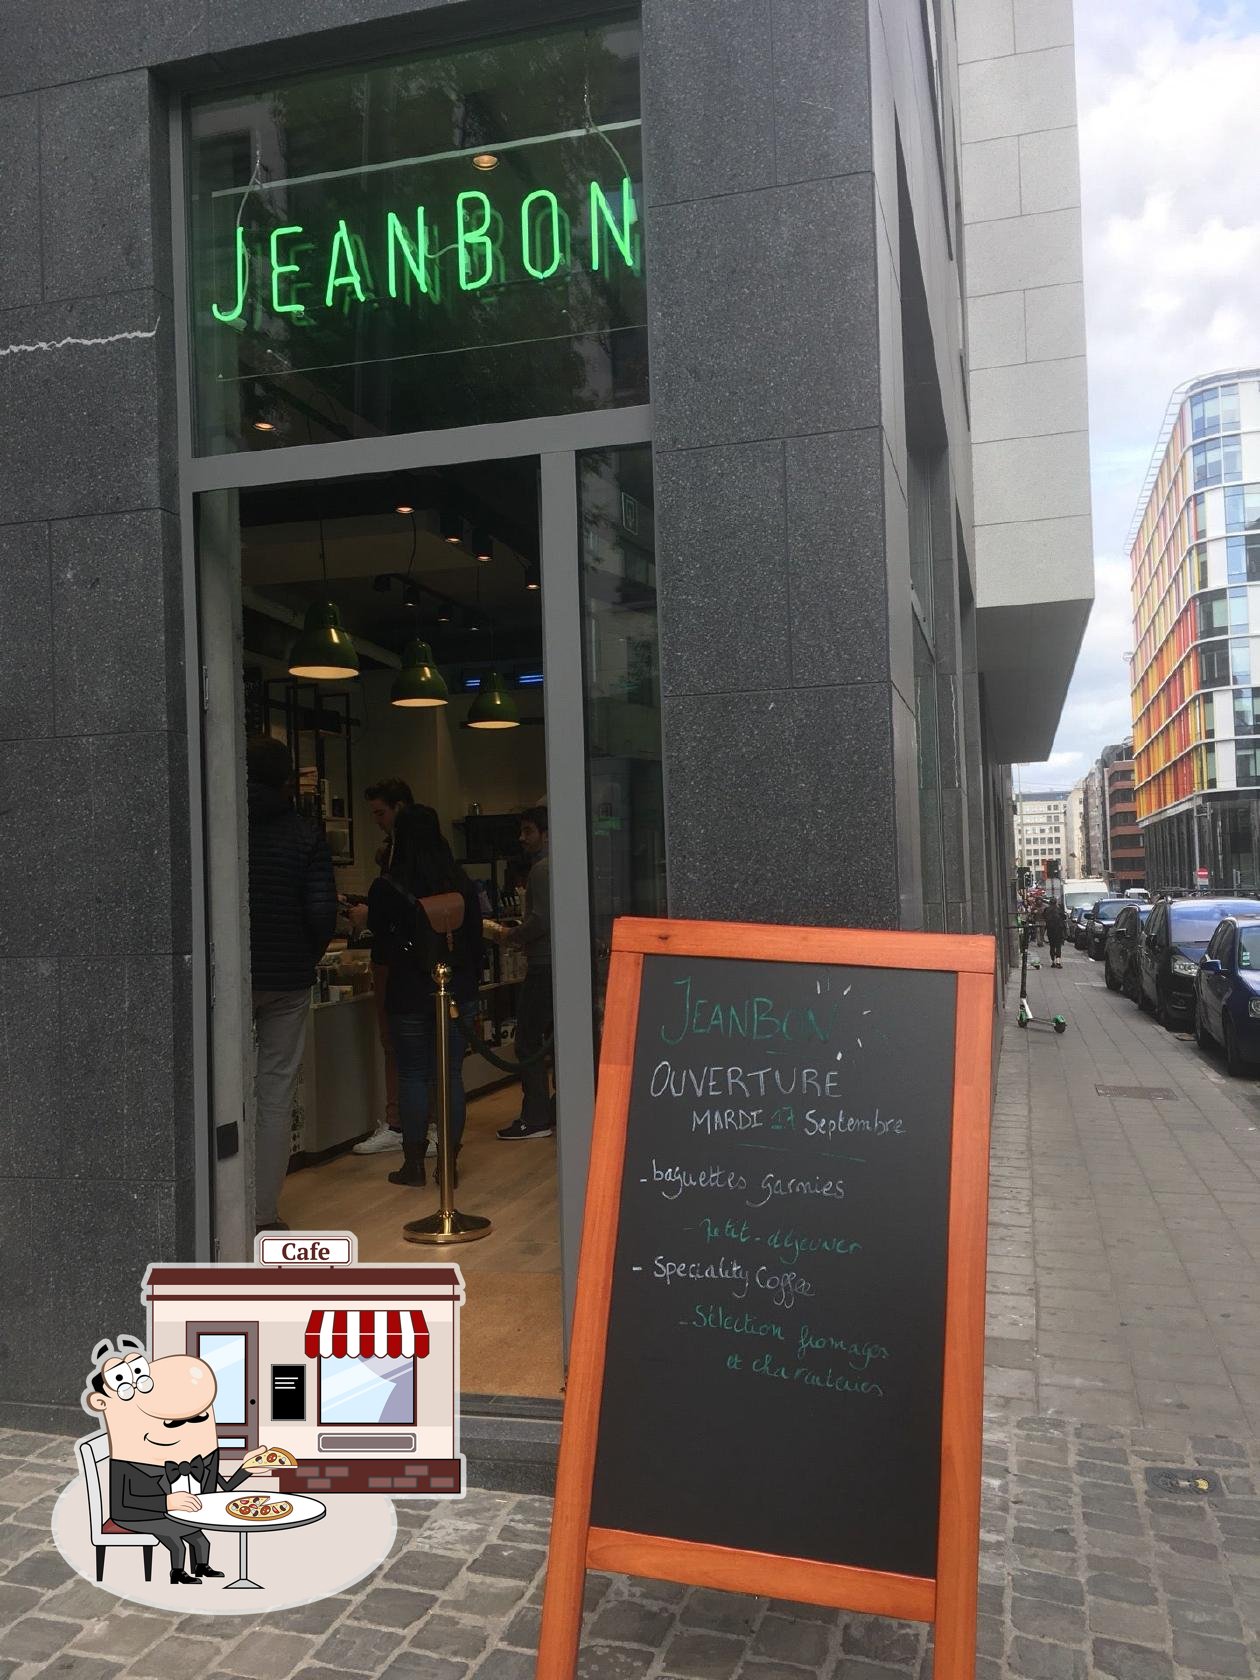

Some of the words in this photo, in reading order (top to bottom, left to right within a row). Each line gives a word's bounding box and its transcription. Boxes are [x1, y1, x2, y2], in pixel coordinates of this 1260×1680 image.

[212, 177, 635, 323] JEANBON
[650, 1060, 843, 1098] OUVERTURE
[691, 1108, 764, 1135] MARDI
[804, 1108, 907, 1142] Septembre
[652, 1158, 748, 1200] baguettes
[745, 1173, 845, 1208] garnies
[653, 1255, 750, 1299] Speciality
[755, 1266, 817, 1309] Coffee
